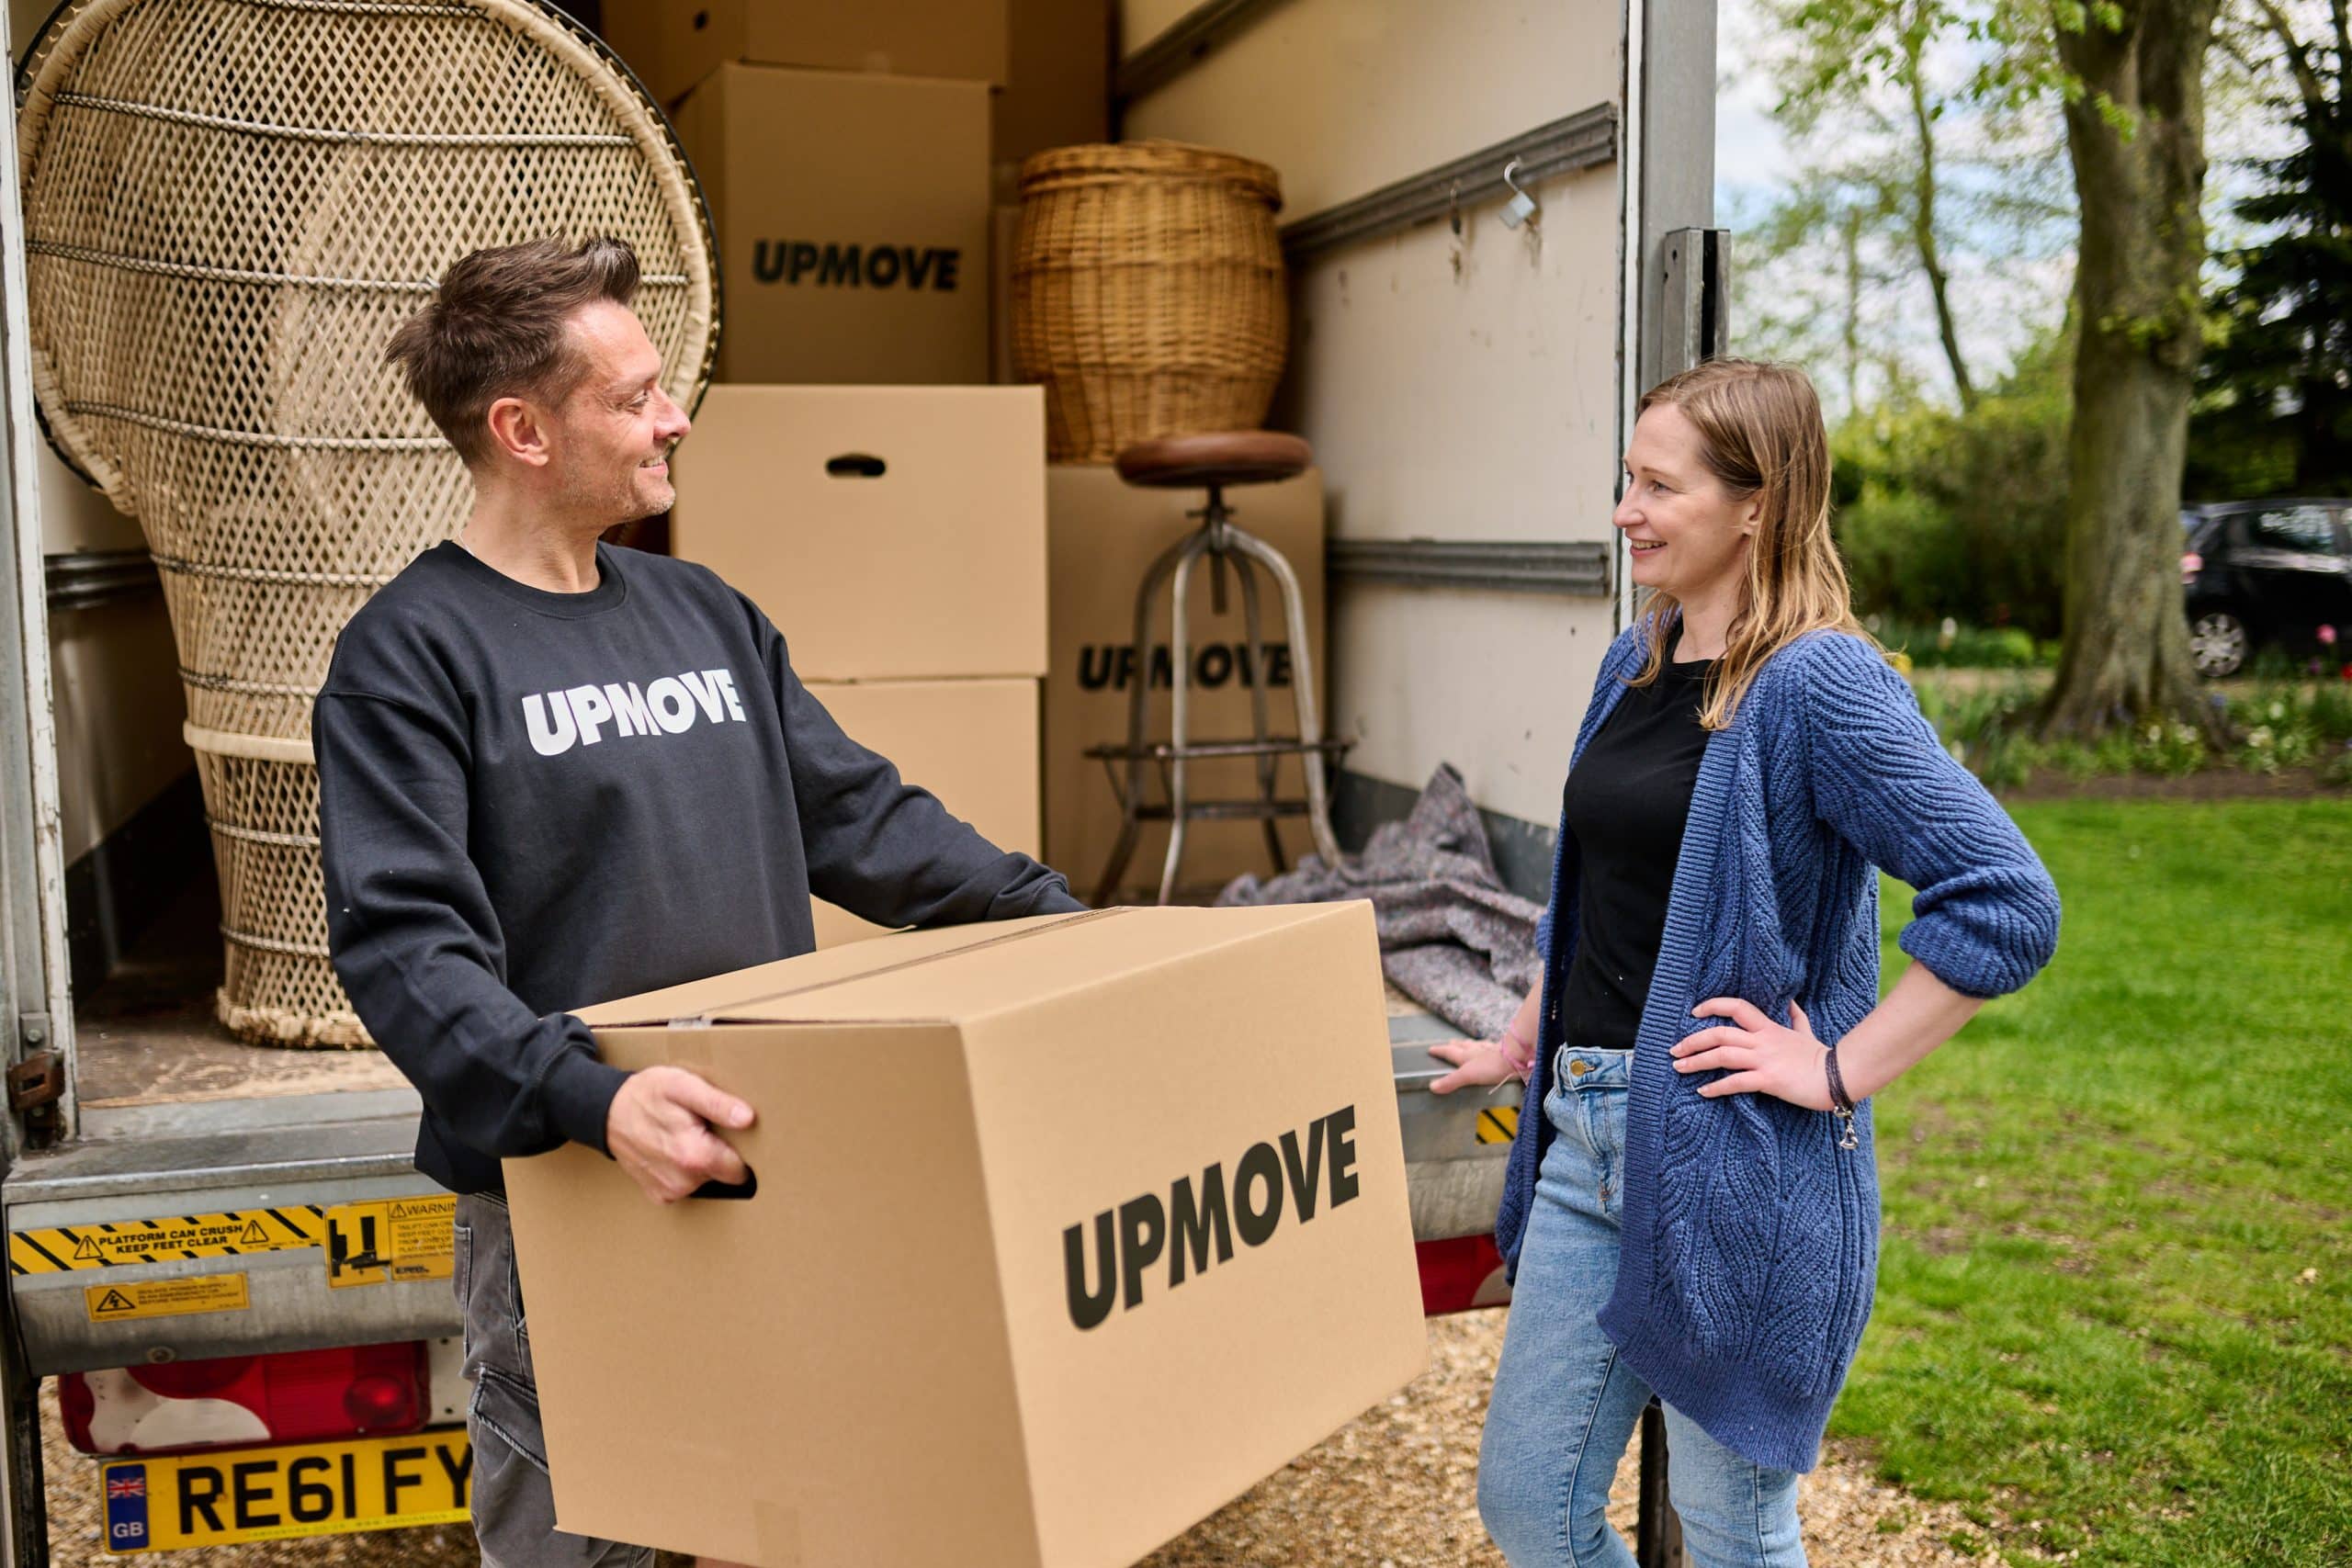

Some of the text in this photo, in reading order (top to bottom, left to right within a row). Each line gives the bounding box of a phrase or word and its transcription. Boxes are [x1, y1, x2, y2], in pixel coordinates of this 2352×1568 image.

[753, 240, 960, 291] UPMOVE
[522, 669, 747, 756] UPMOVE
[99, 1224, 243, 1246] PLATFORM CAN CRUSH
[1063, 1104, 1360, 1331] UPMOVE
[116, 1235, 228, 1254] KEEP FEET CLEAR
[176, 1454, 356, 1534] RE61
[113, 1520, 144, 1539] GB
